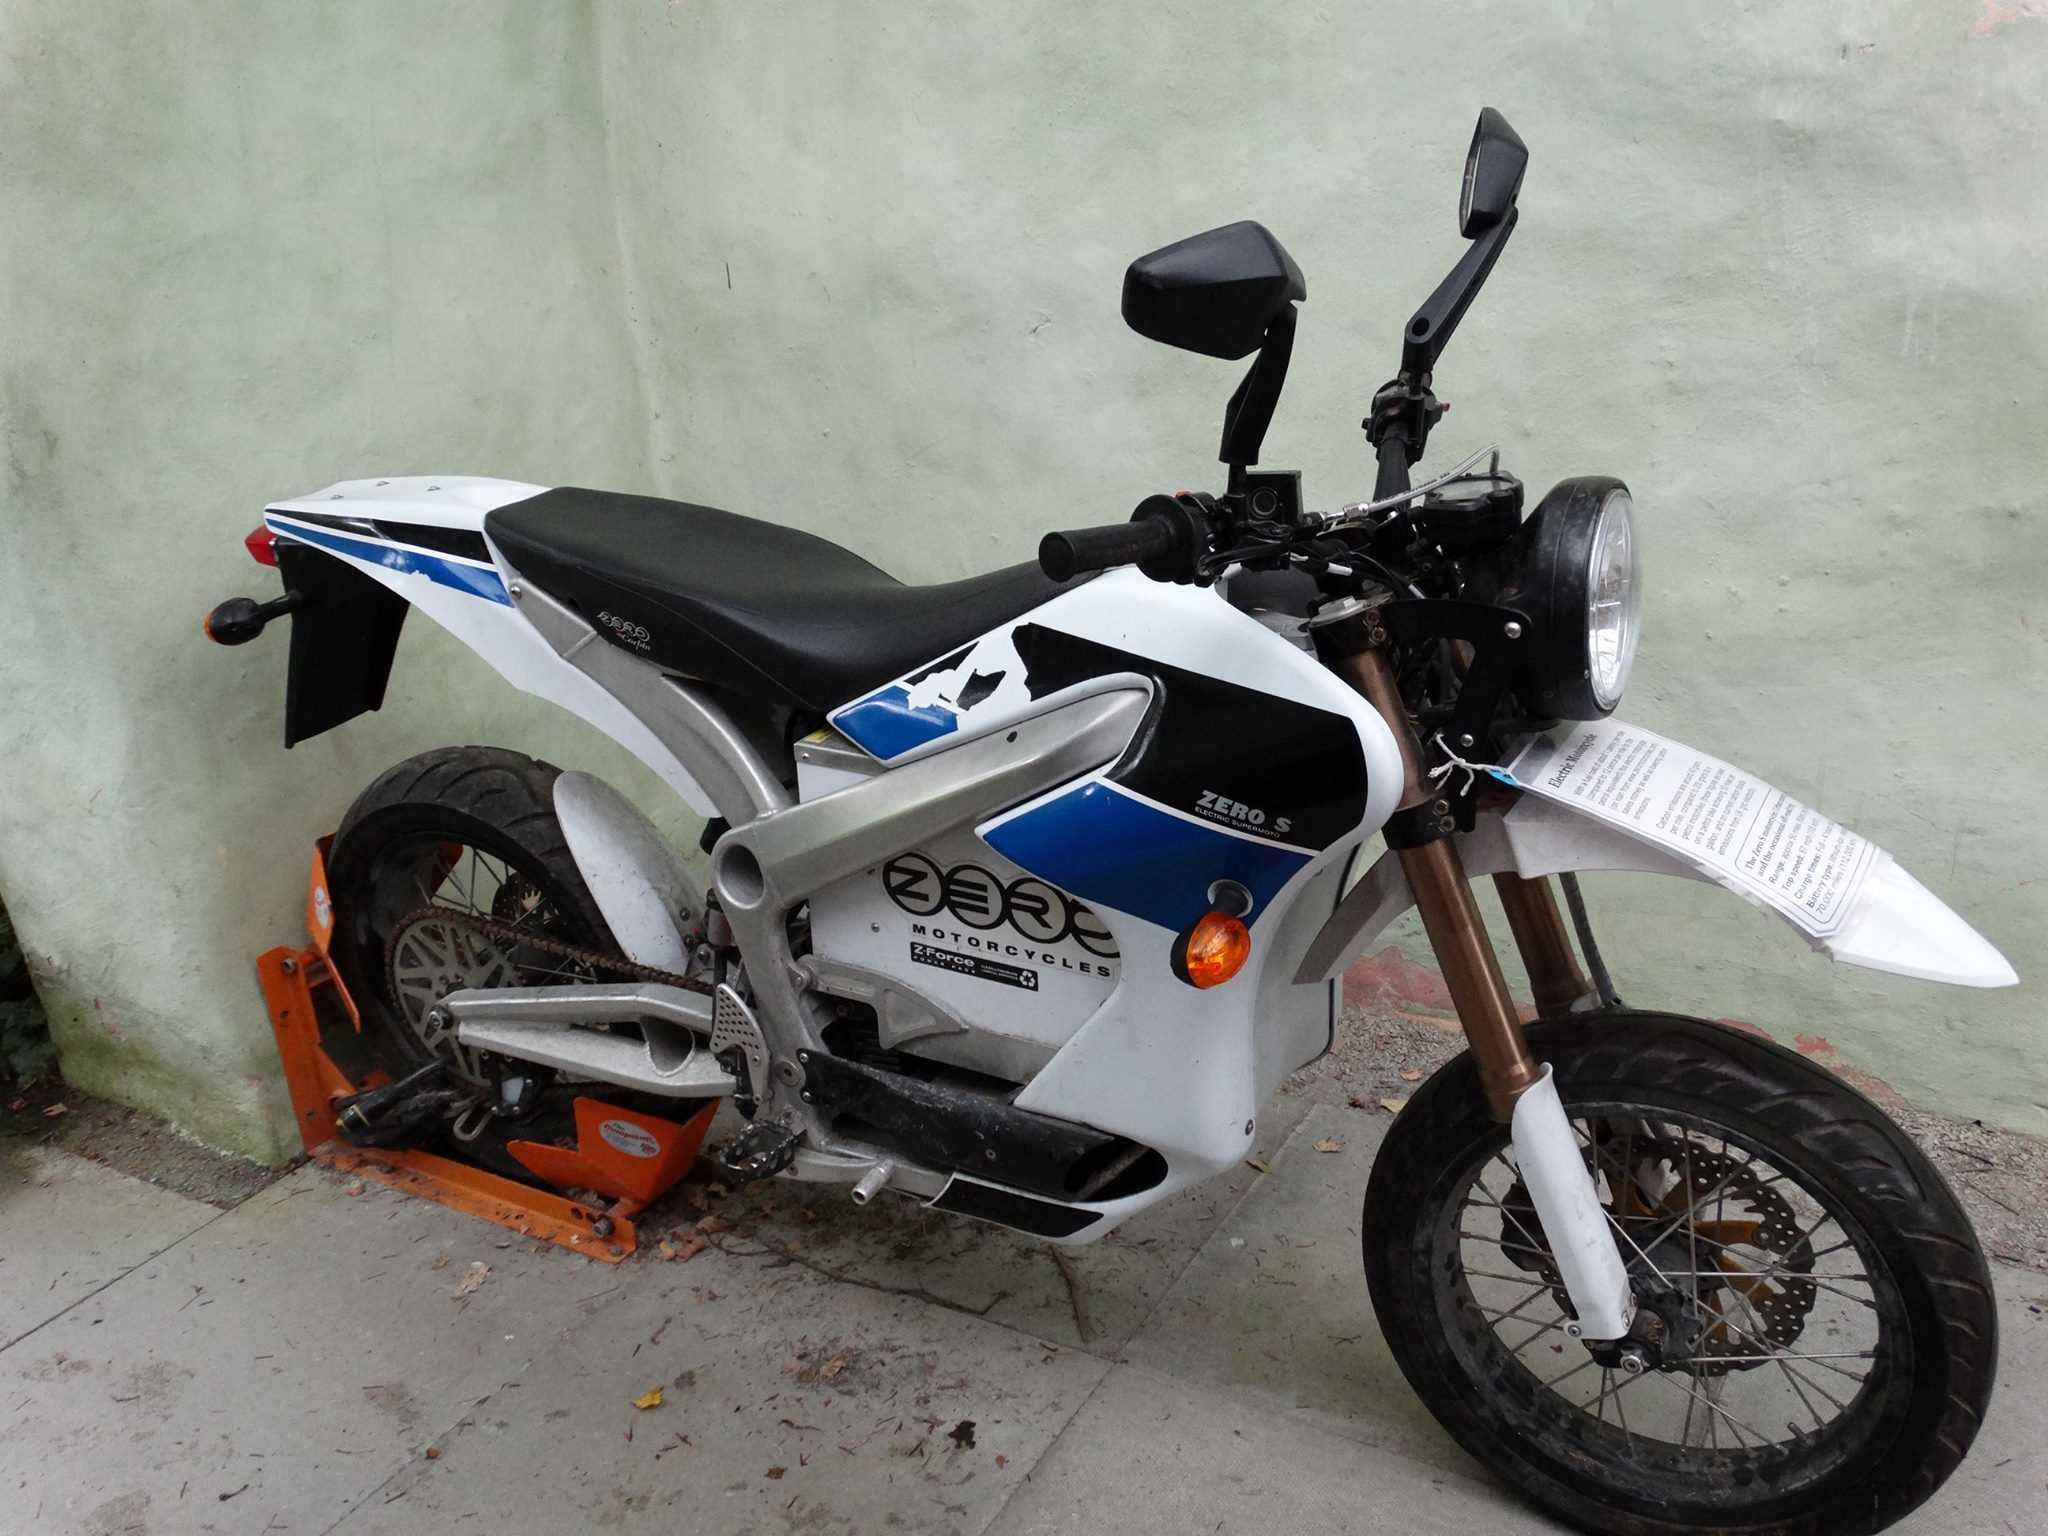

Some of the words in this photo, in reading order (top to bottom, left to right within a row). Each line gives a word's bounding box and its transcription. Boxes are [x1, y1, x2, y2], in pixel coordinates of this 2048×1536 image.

[1548, 762, 1574, 788] Electric
[1194, 806, 1231, 824] ELECTRIC
[1196, 789, 1265, 825] ZERO
[1273, 816, 1293, 833] S
[912, 923, 1111, 977] MOTORCYCLES
